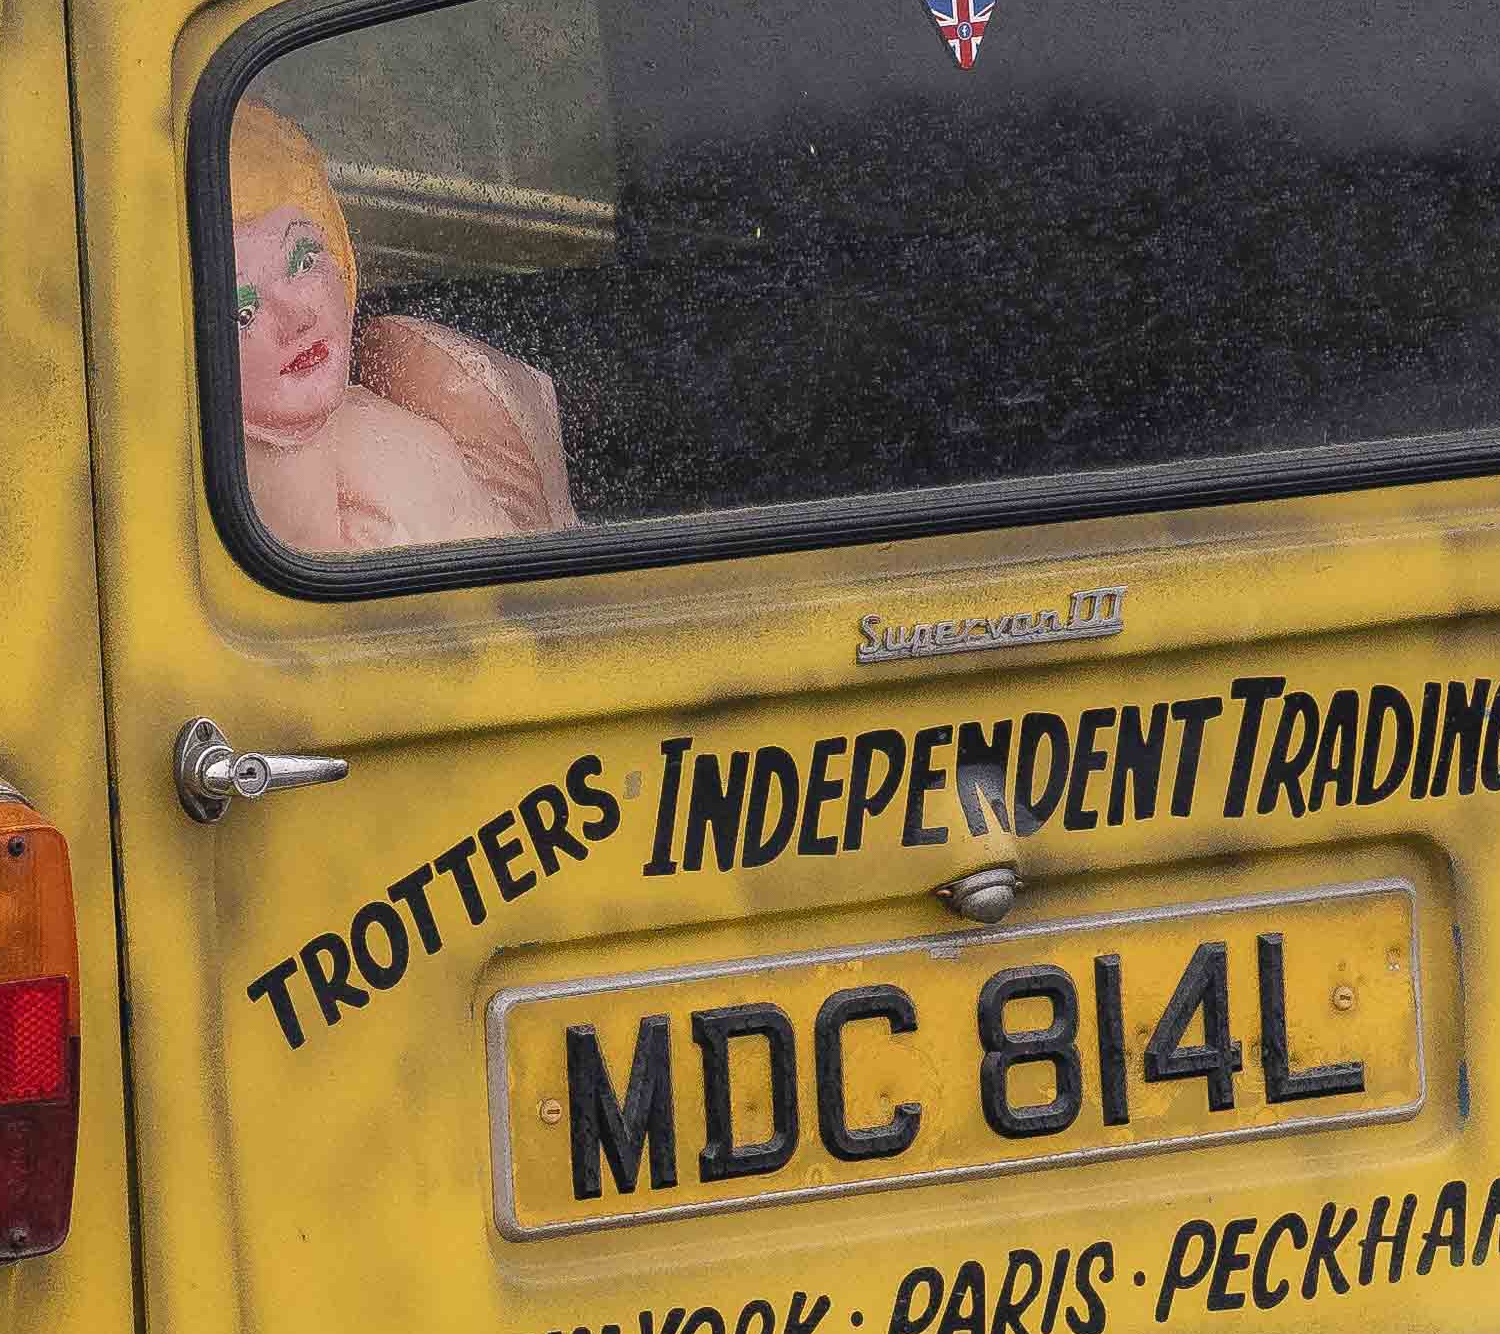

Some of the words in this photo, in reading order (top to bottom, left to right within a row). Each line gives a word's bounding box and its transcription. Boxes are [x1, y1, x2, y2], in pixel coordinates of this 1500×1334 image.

[245, 753, 622, 1051] TROTTERS
[642, 695, 1225, 878] INDEPENDENT
[564, 982, 923, 1203] MDC
[975, 932, 1368, 1141] 814L
